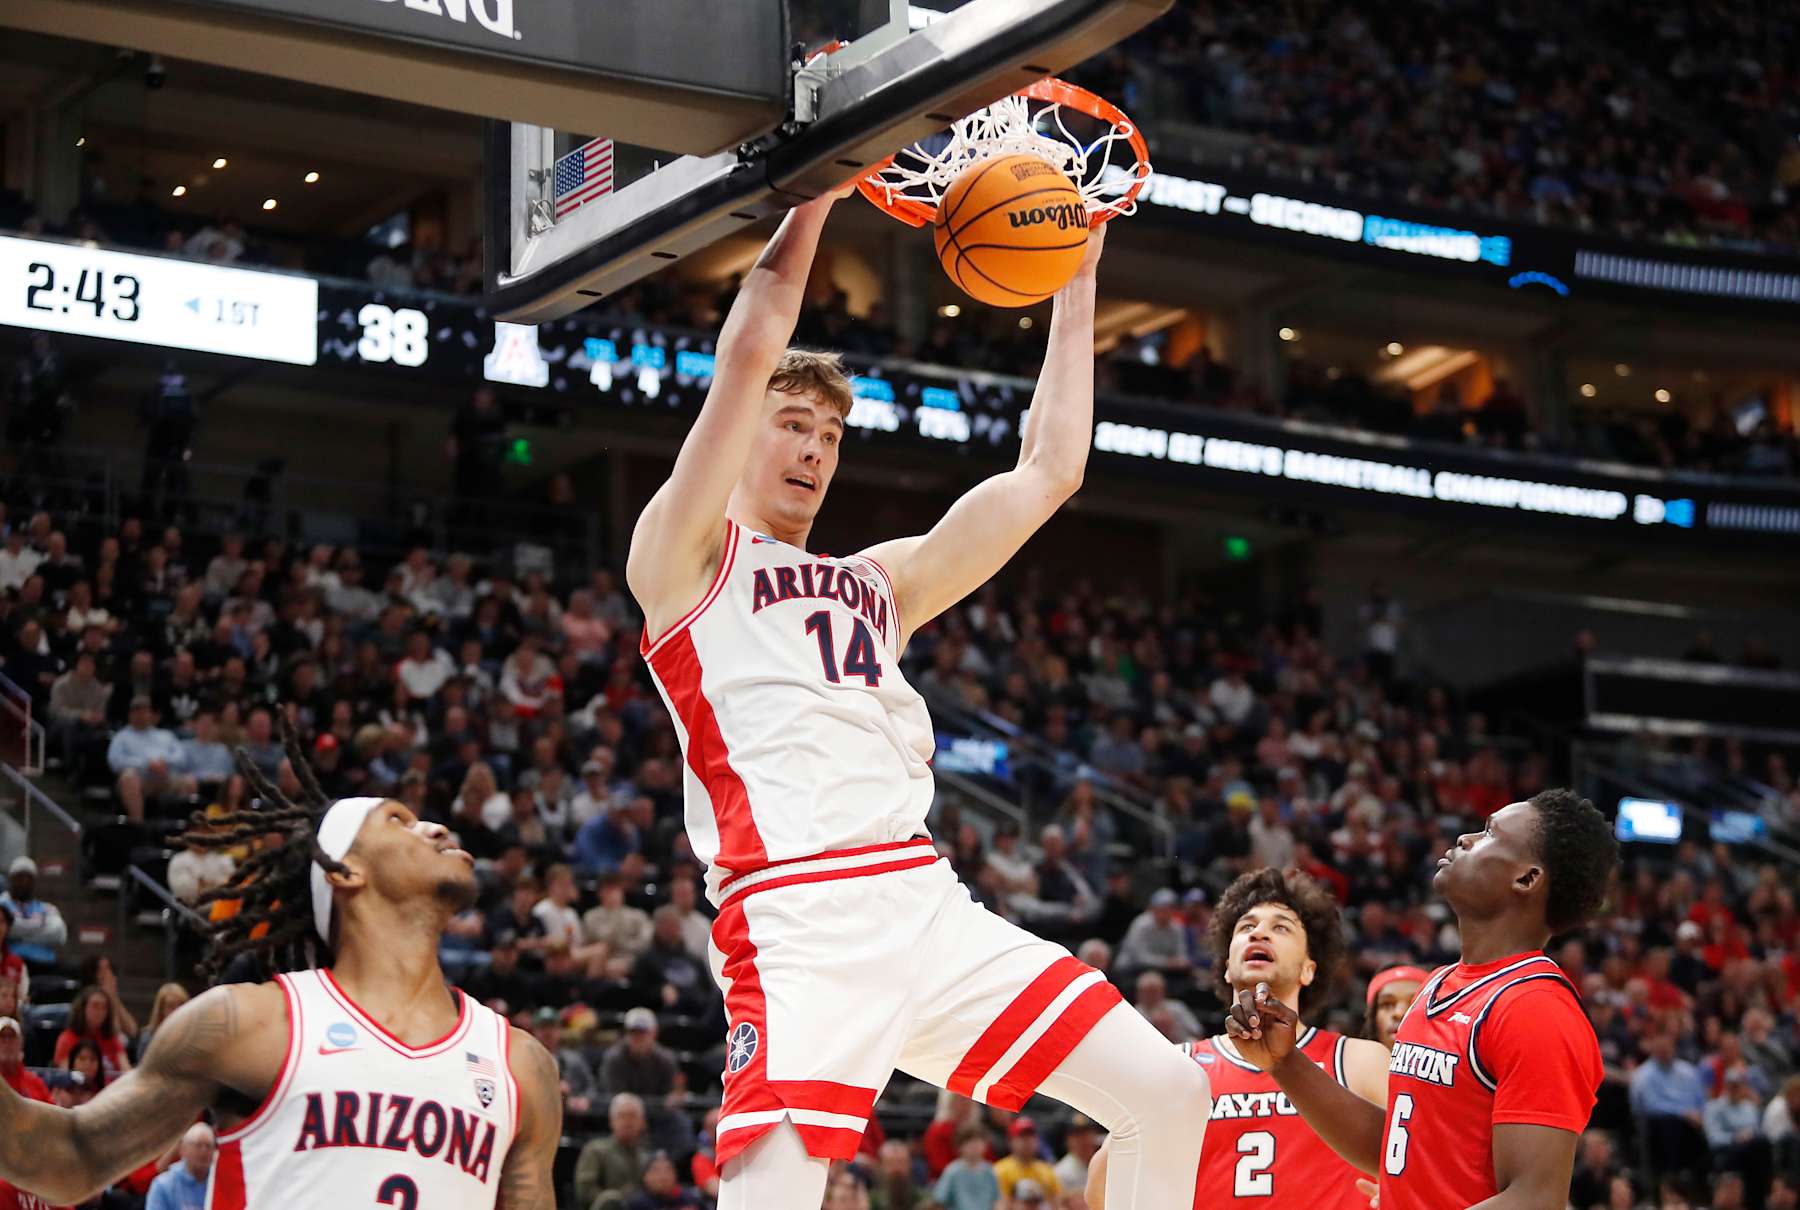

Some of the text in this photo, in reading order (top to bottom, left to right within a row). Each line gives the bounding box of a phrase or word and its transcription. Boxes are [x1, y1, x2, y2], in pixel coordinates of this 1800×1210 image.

[1008, 203, 1088, 230] Wilson
[1250, 193, 1363, 242] SECOND
[27, 262, 260, 329] 2:43 1ST
[358, 303, 429, 367] 38
[1094, 421, 1168, 459] 2024
[1204, 437, 1284, 476] MEN'S
[1284, 449, 1433, 498] BASKETBALL
[1433, 471, 1628, 520] CHAMPIONSHIP
[753, 563, 887, 647] ARIZONA
[804, 610, 883, 688] 14
[294, 1090, 497, 1184] ARIZONA
[1209, 1091, 1298, 1120] AYTO
[1385, 1093, 1414, 1176] 6
[1233, 1131, 1276, 1198] 2
